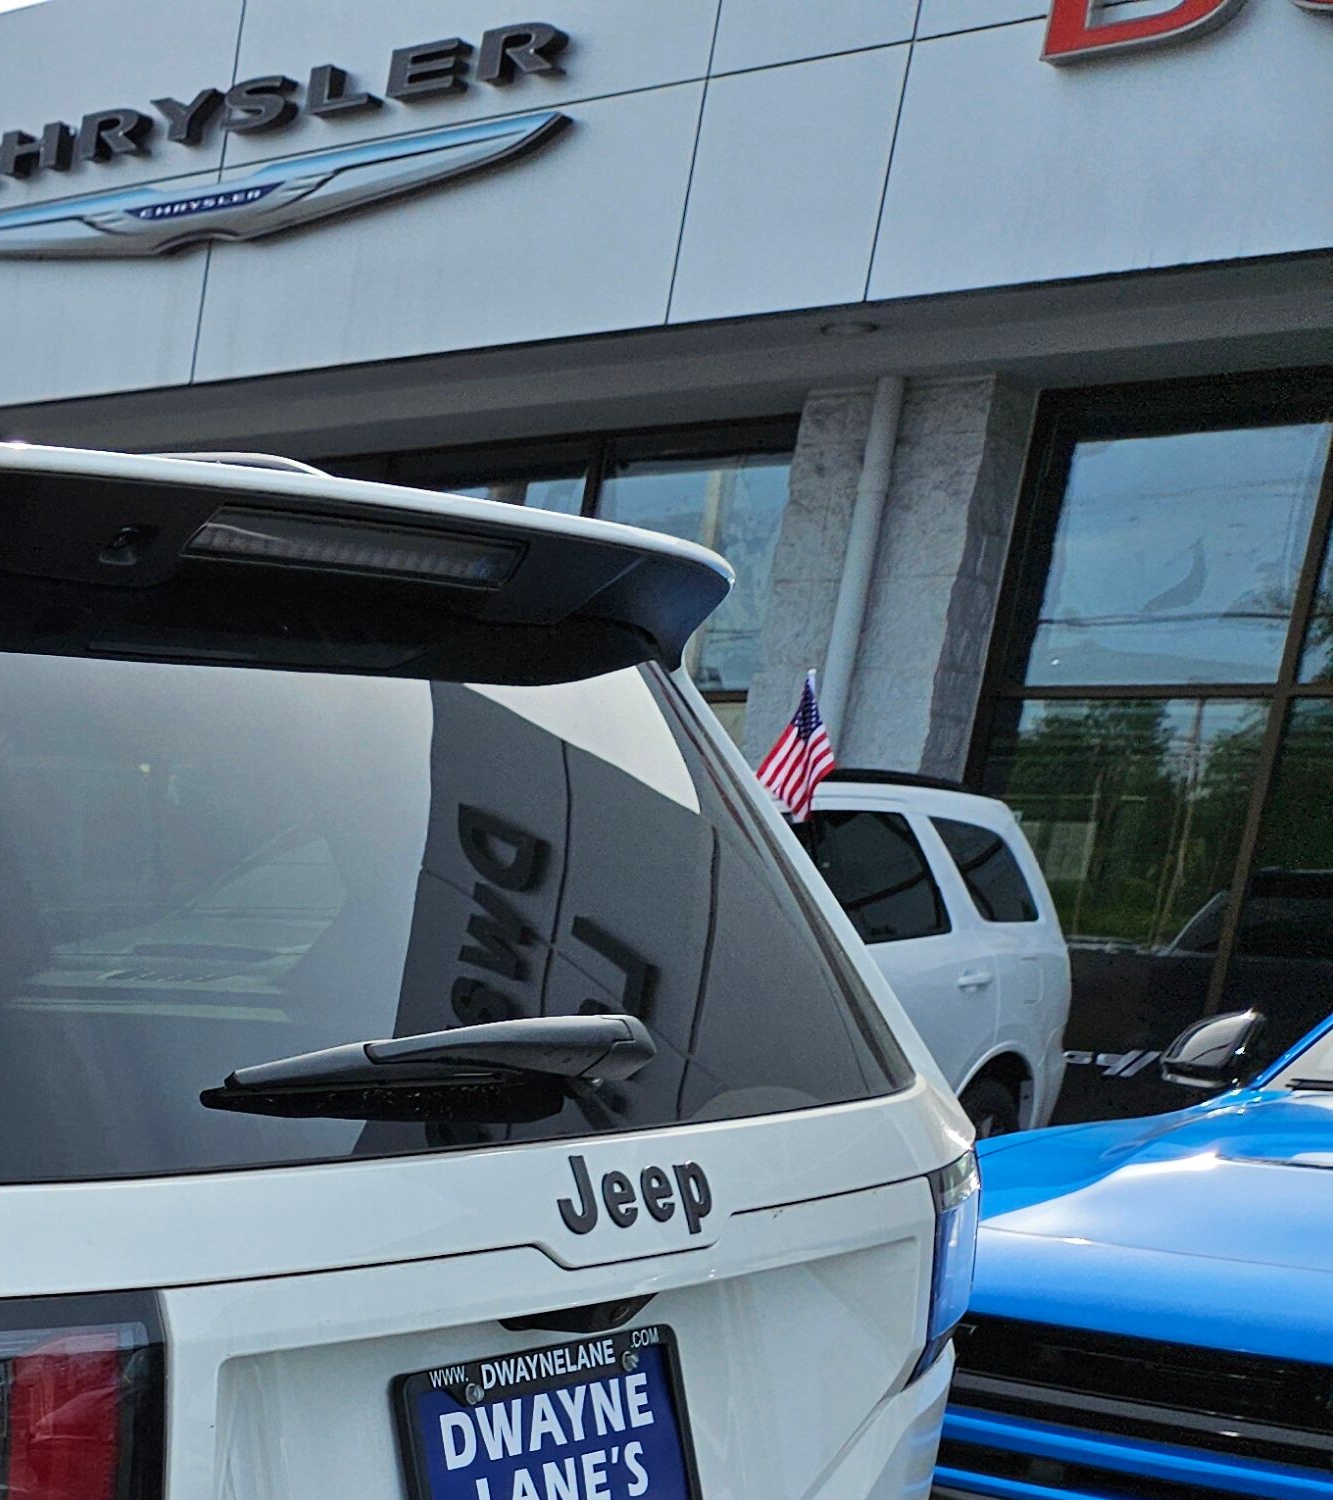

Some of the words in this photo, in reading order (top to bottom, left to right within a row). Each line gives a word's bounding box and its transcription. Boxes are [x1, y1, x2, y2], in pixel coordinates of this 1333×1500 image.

[139, 189, 261, 219] CHRYSLER
[557, 1155, 713, 1235] Jeep
[481, 1339, 616, 1390] DWAYNELANE
[439, 1373, 654, 1470] DWAYNE
